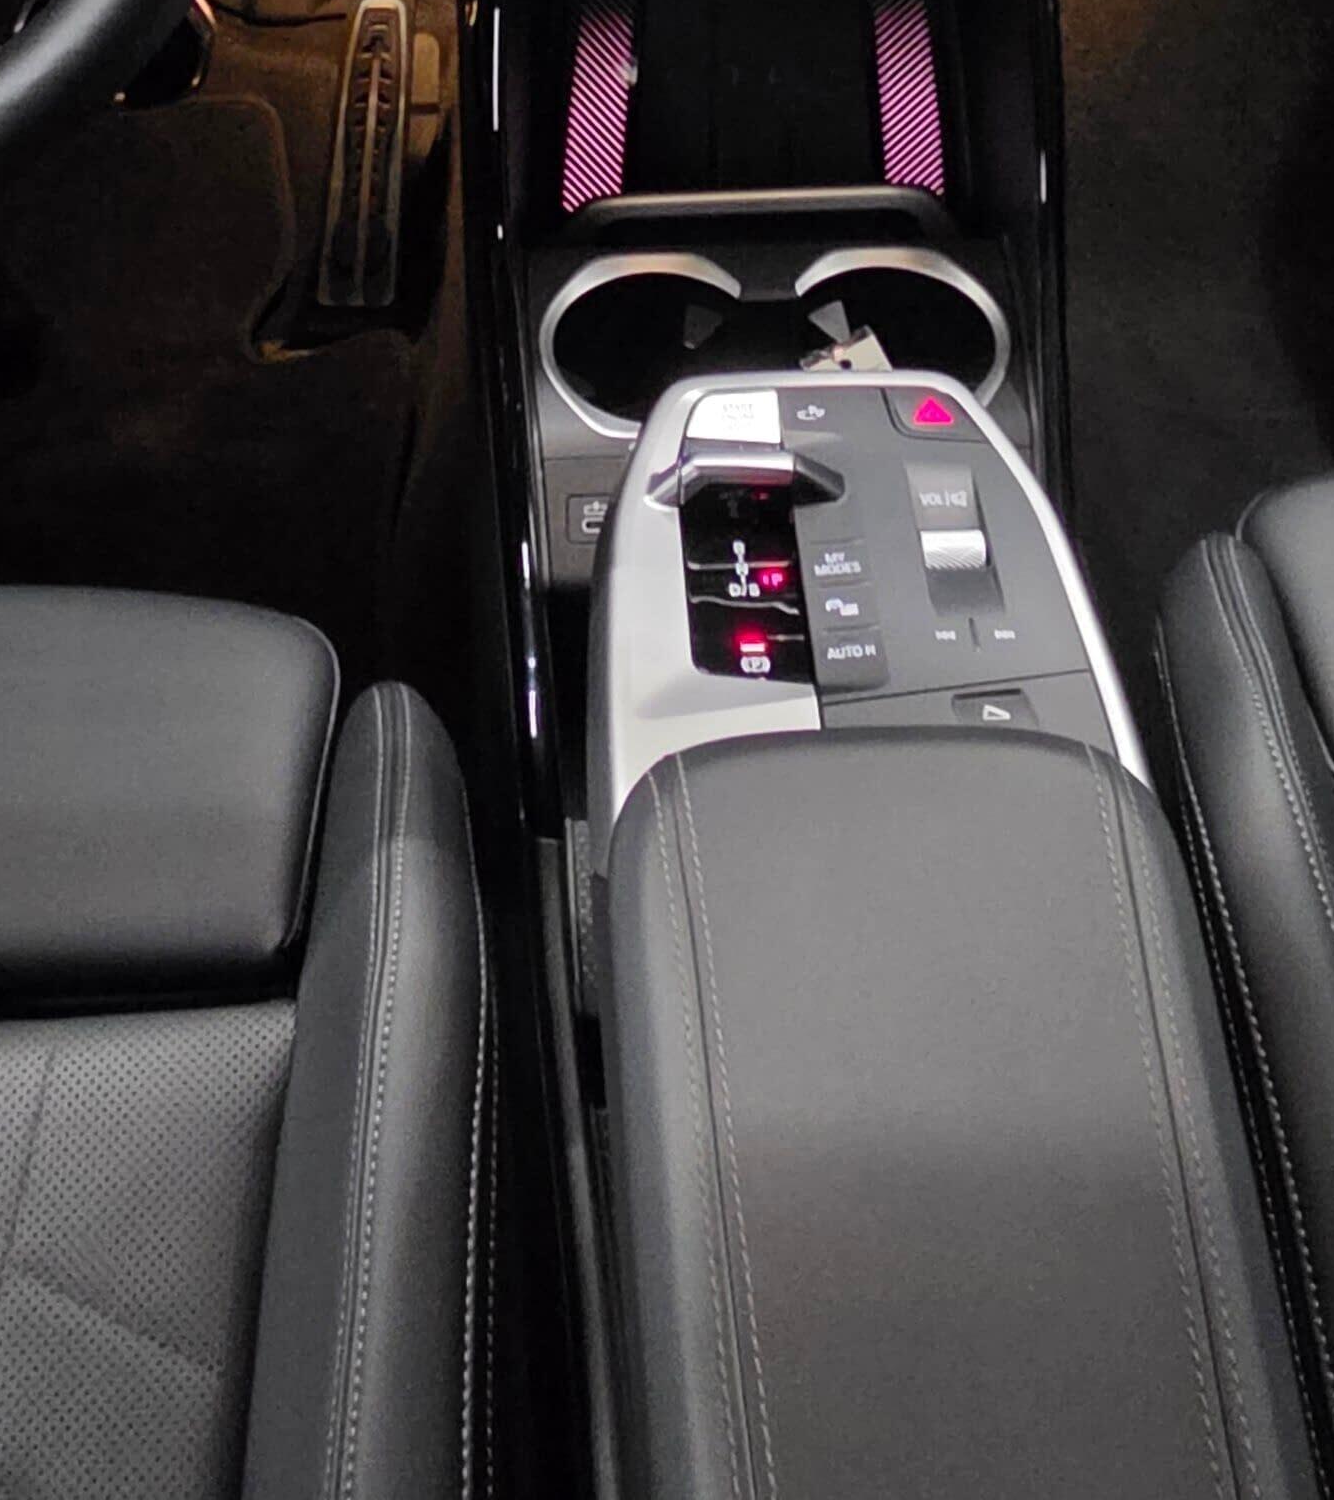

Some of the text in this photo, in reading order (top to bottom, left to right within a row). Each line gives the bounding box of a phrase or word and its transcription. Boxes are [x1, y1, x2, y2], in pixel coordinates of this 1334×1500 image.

[918, 491, 942, 507] VOL
[824, 551, 845, 563] MY
[813, 560, 862, 577] MODES
[827, 644, 864, 660] AUTO
